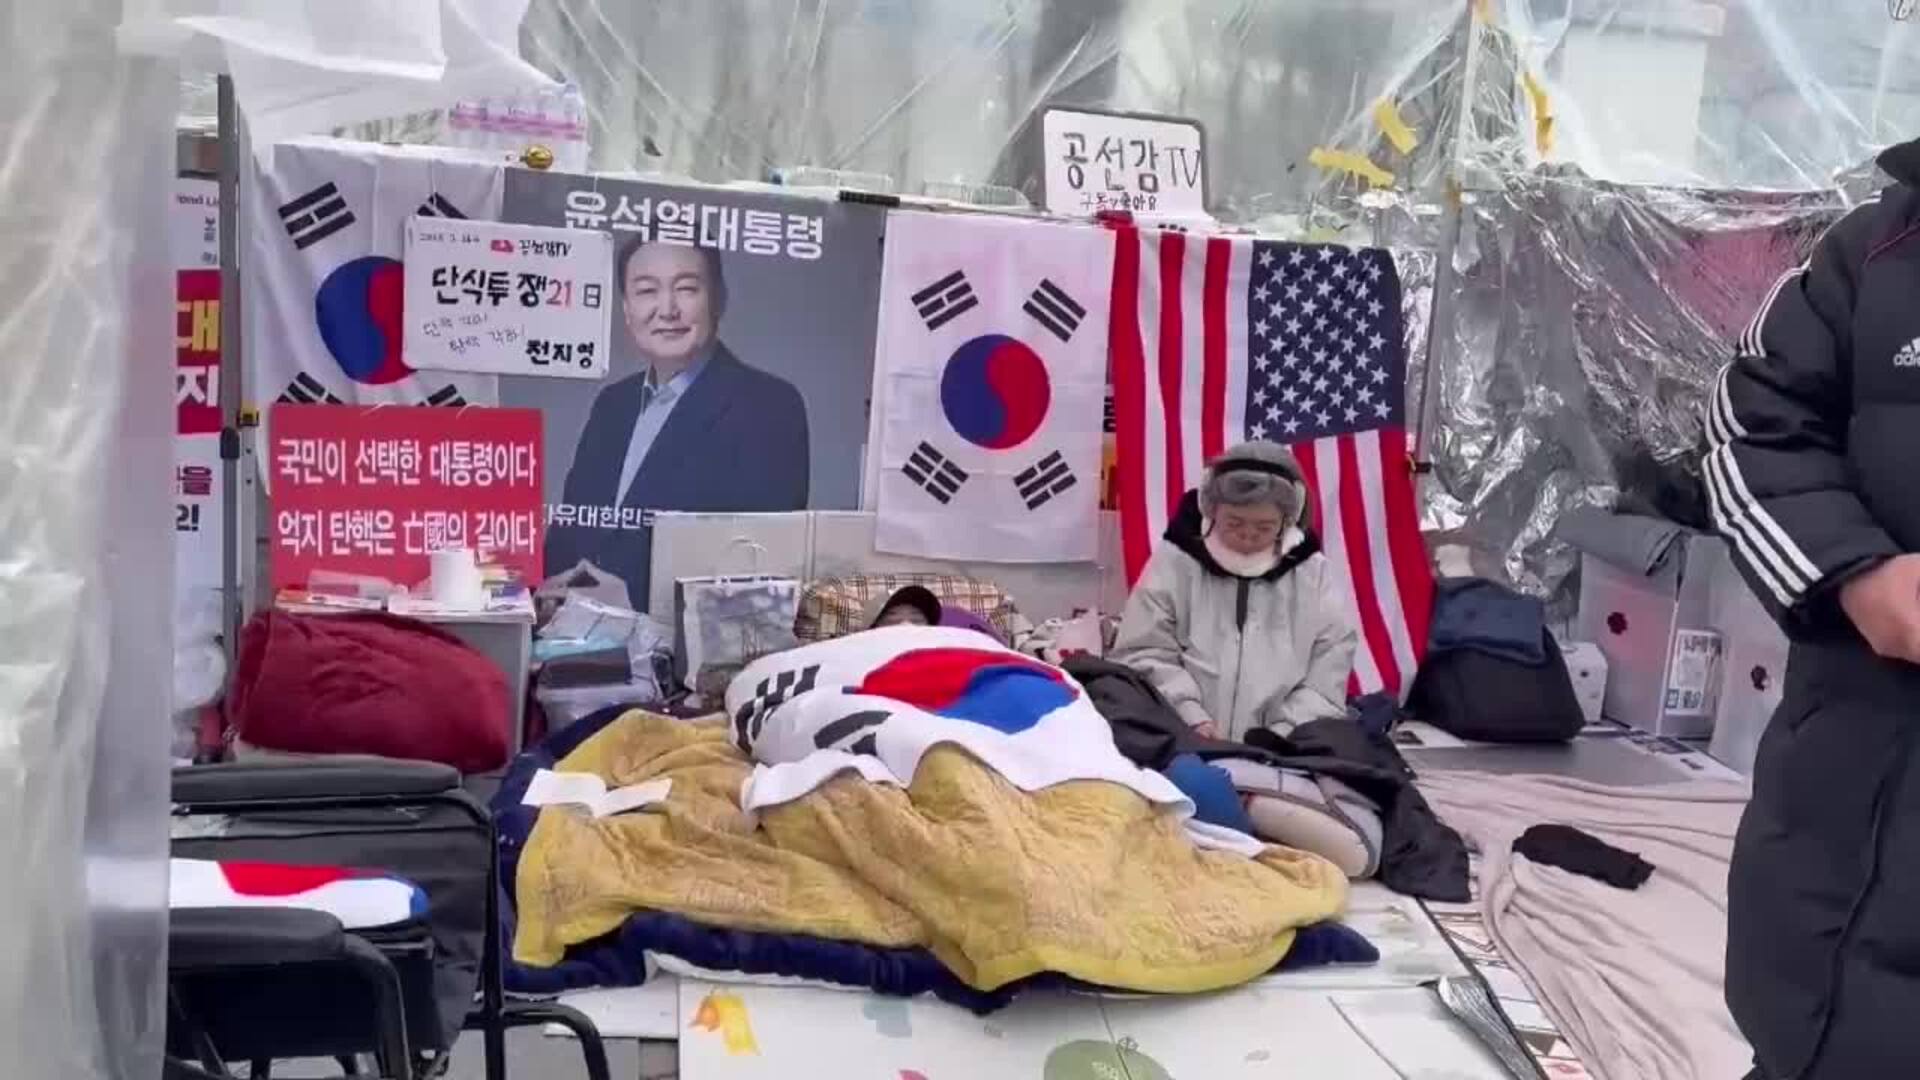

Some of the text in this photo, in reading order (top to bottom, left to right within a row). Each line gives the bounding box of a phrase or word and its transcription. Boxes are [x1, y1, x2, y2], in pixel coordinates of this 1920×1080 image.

[564, 189, 824, 261] 윤석열대통령
[277, 438, 537, 488] 국민이 선택한 대통령이다
[277, 509, 323, 557] 억지
[329, 509, 397, 556] 탄핵은
[474, 510, 537, 556] 길이다
